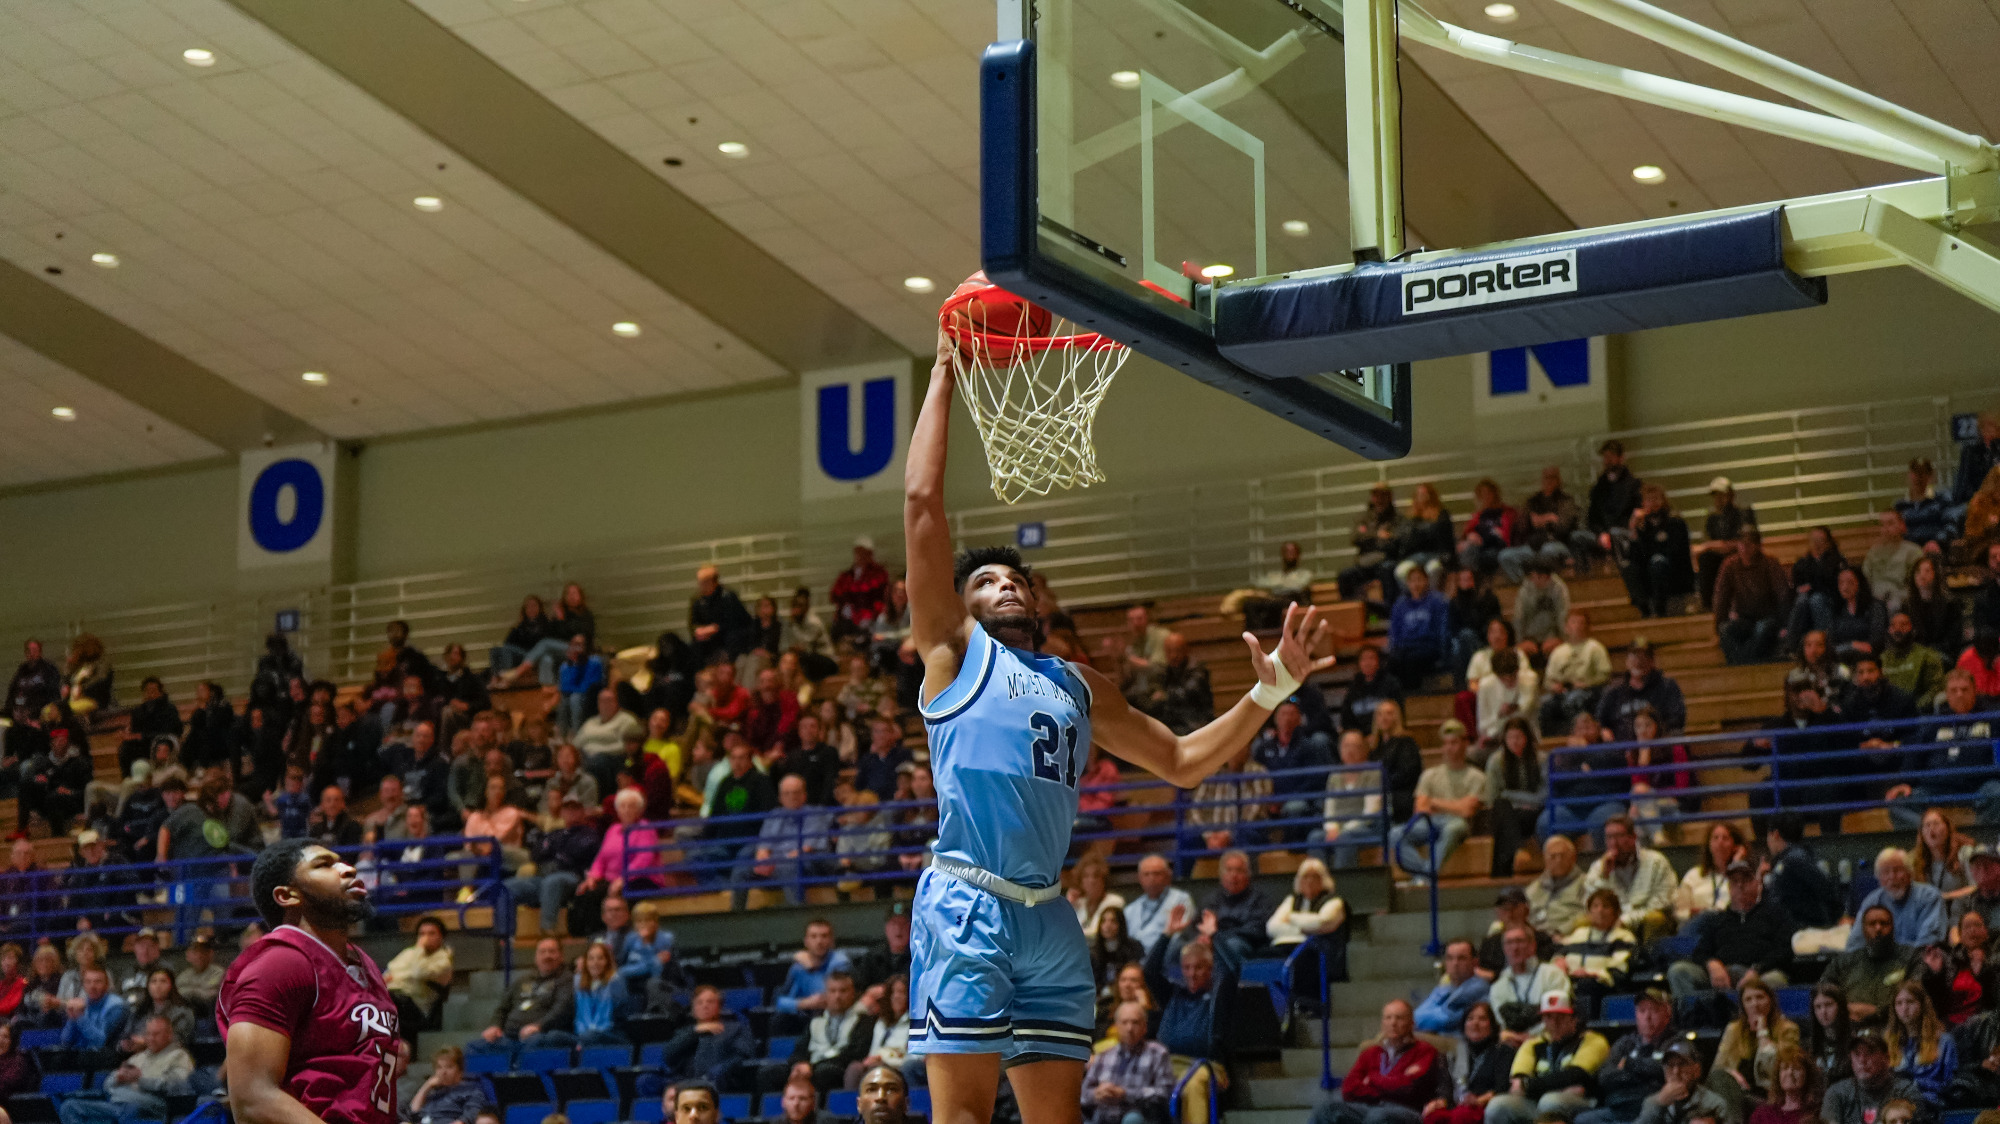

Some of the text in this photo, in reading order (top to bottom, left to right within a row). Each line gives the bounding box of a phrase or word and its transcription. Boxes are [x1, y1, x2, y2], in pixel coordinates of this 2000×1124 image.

[817, 375, 896, 482] U
[248, 457, 325, 554] O
[1028, 710, 1078, 790] 21
